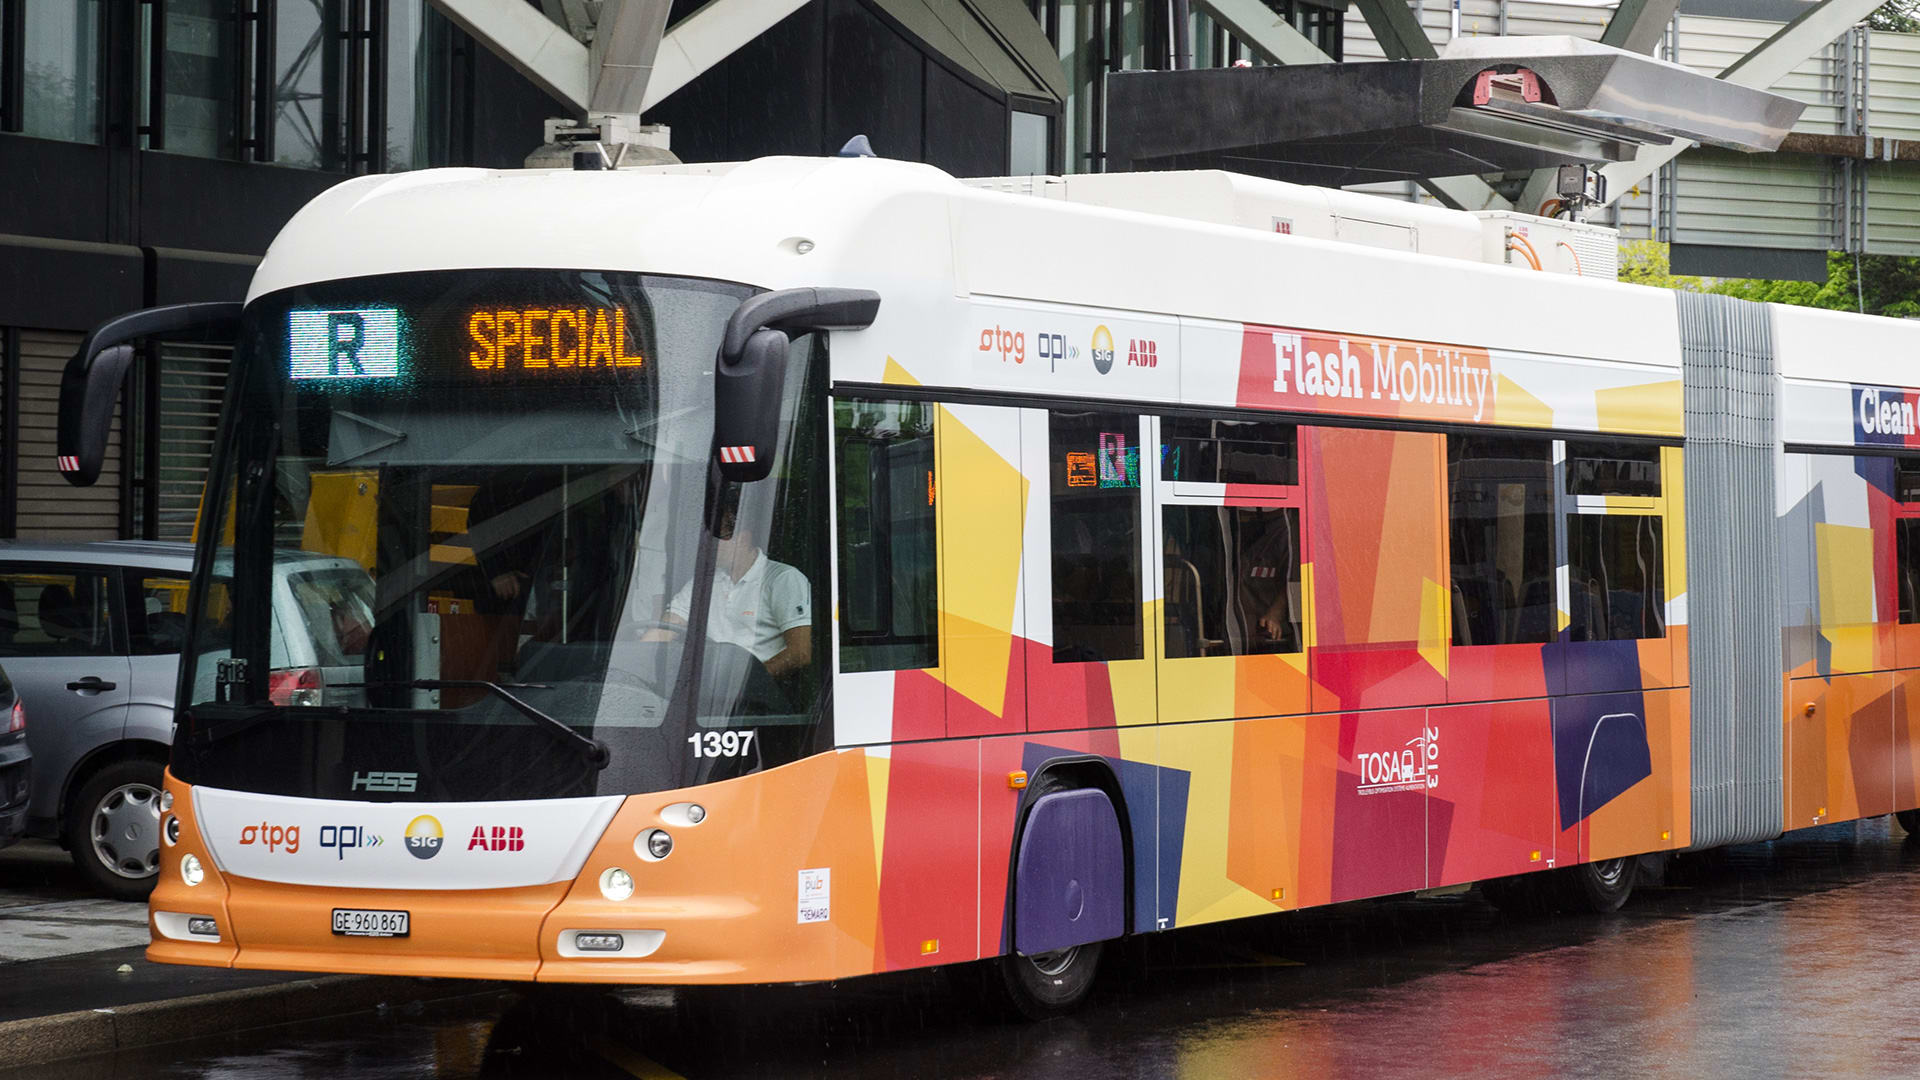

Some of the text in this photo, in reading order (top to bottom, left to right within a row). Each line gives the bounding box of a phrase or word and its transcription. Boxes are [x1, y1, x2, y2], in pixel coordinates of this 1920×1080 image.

[328, 312, 365, 375] R
[469, 308, 643, 369] SPECIAL
[1127, 338, 1158, 368] ABB
[1095, 349, 1112, 361] SIG
[1272, 332, 1489, 422] Flash Mobility
[1860, 387, 1915, 435] Clean
[688, 730, 754, 758] 1397
[1426, 726, 1439, 788] 2013
[351, 771, 419, 793] HESS
[1357, 751, 1402, 785] TOSA
[410, 836, 438, 848] SIG
[467, 825, 525, 852] ABB
